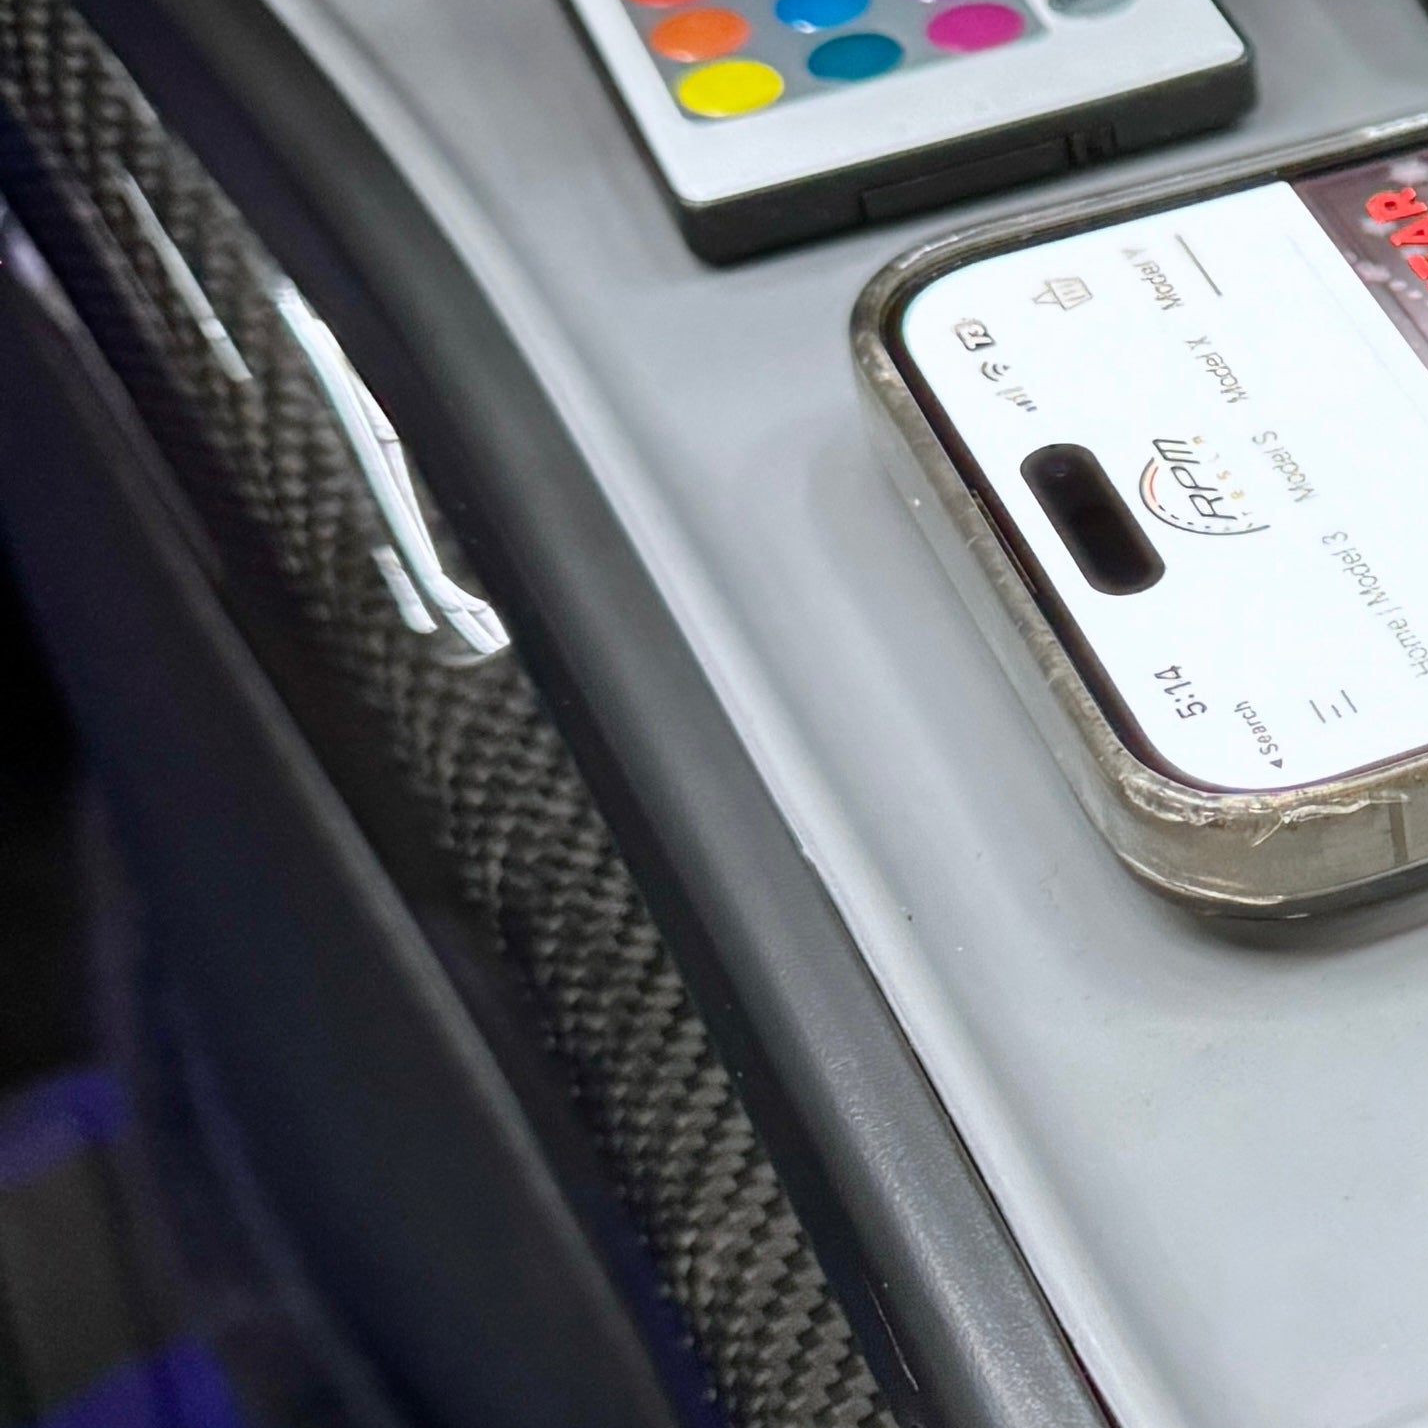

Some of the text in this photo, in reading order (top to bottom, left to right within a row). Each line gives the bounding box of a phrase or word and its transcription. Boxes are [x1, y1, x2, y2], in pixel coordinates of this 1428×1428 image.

[1132, 259, 1186, 311] Model
[1184, 334, 1250, 404] Model X
[1150, 431, 1238, 528] RPM
[1249, 428, 1319, 502] Model S
[1319, 529, 1351, 547] 3
[1330, 546, 1392, 607] Model
[1151, 663, 1210, 720] 5:14
[1229, 699, 1281, 756] Search
